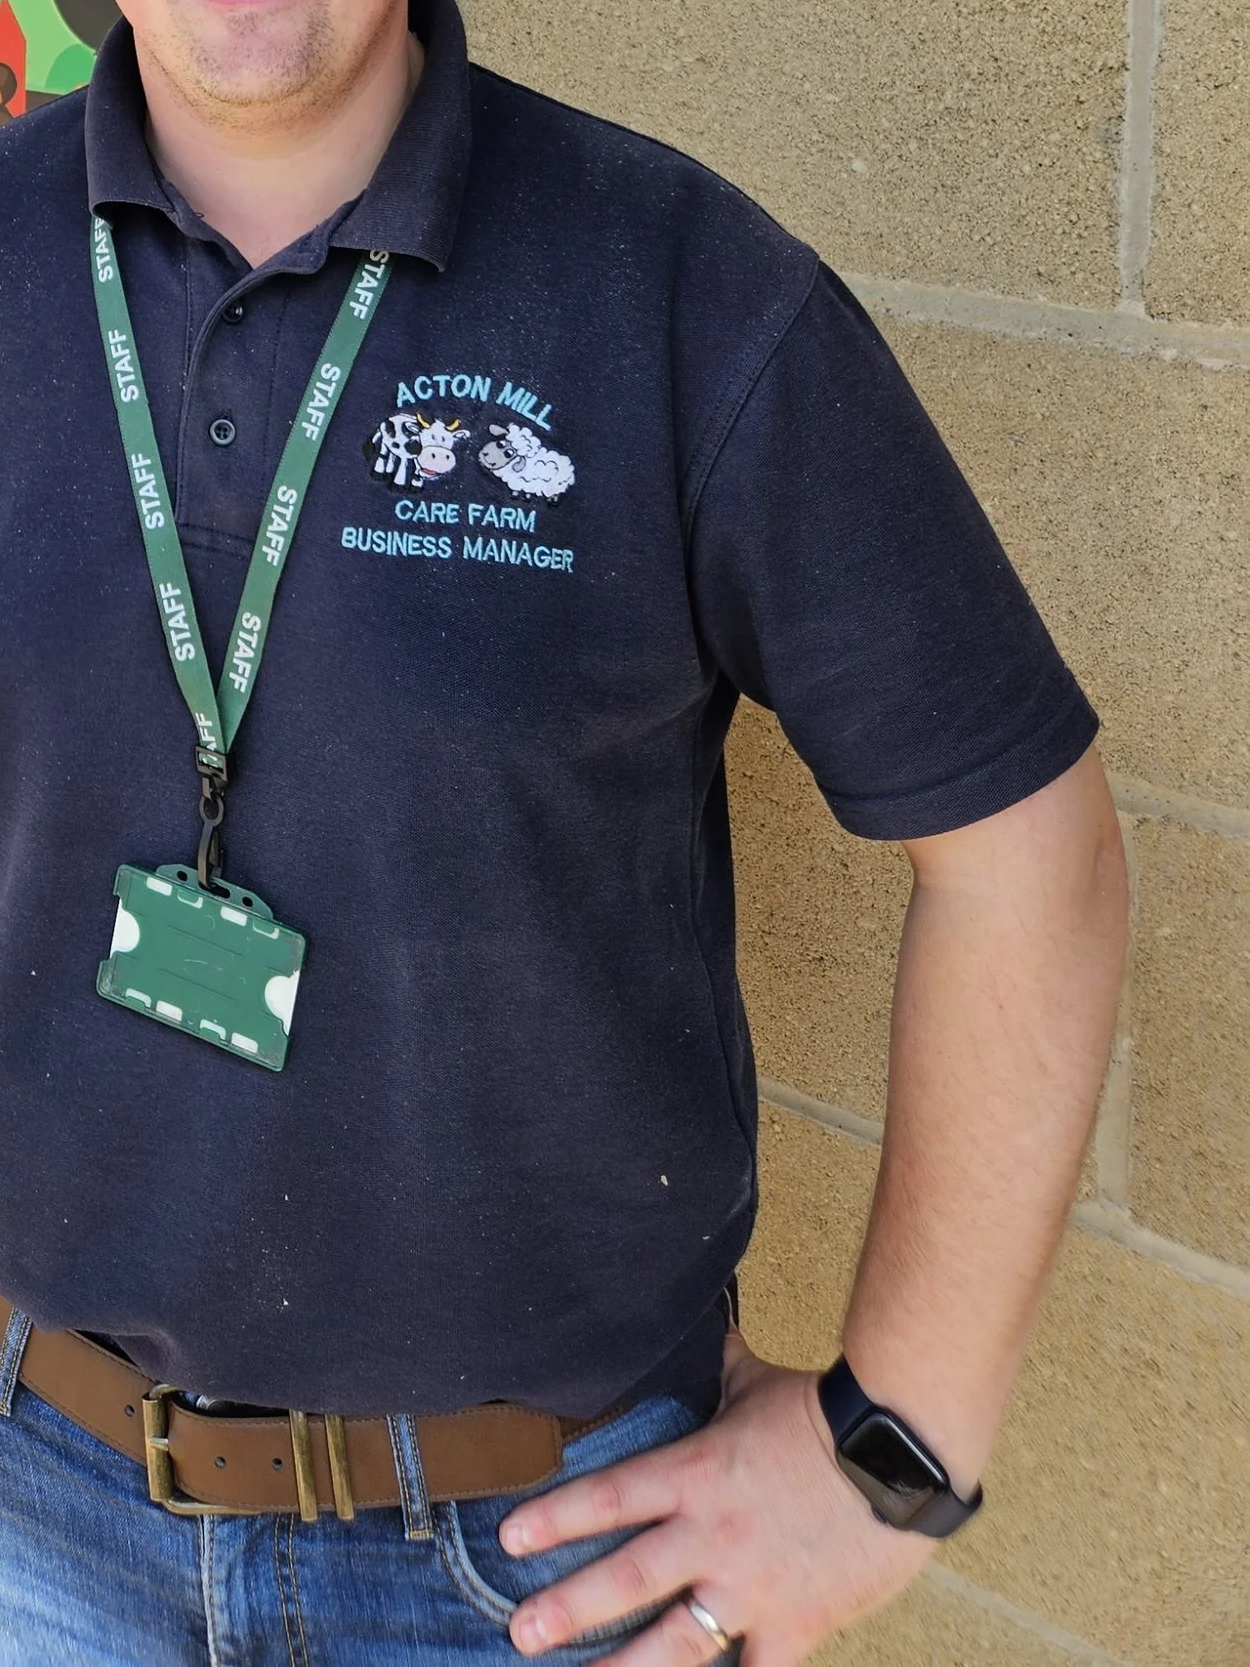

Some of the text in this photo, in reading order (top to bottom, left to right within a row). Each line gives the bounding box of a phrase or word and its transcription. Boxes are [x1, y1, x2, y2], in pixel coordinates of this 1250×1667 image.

[350, 249, 389, 320] STAFF
[108, 330, 139, 403] STAFF
[301, 363, 341, 441] STAFF
[396, 374, 553, 430] ACTON MILL
[131, 453, 165, 529] STAFF
[262, 485, 298, 567] STAFF
[395, 500, 537, 533] CARE FARM
[341, 527, 573, 572] BUSINESS MANAGER
[159, 582, 196, 662] STAFF
[229, 612, 262, 693] STAFF
